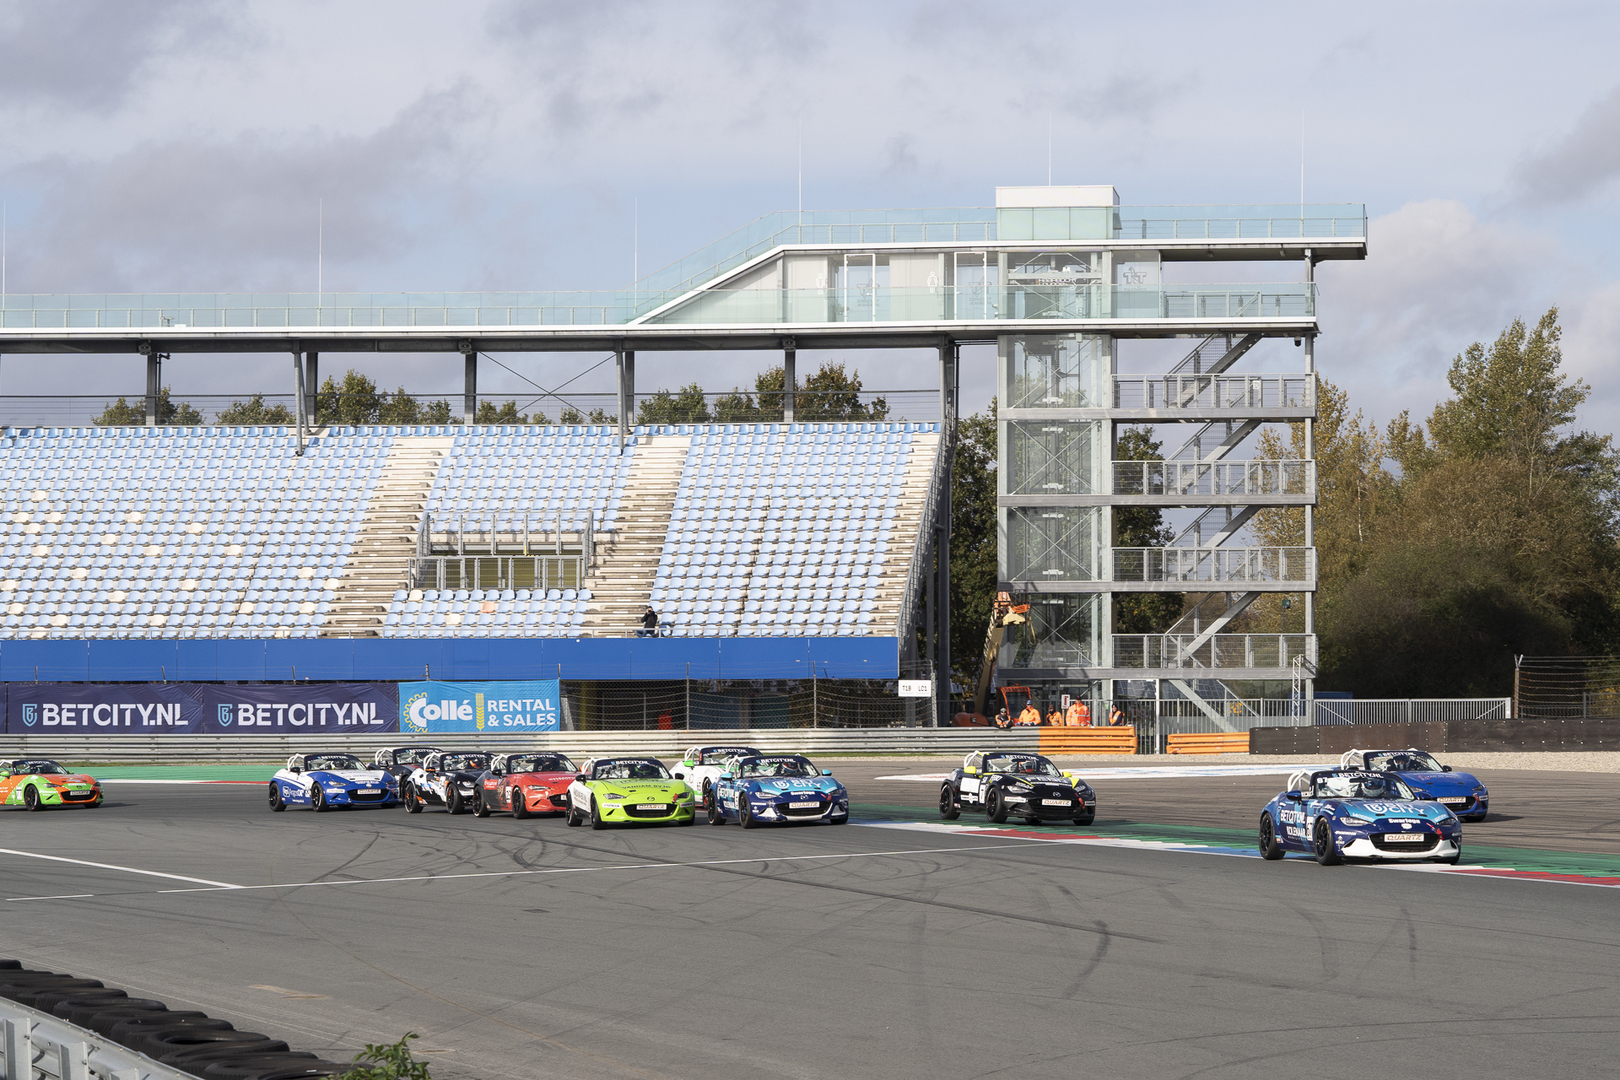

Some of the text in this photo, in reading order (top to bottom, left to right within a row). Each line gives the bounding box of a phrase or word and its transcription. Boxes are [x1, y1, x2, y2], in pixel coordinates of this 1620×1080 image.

[43, 703, 189, 726] BETCITY.NL
[237, 702, 384, 726] BETCITY.NL
[409, 697, 473, 728] Collé
[487, 698, 555, 712] RENTAL
[487, 713, 556, 727] & SALES
